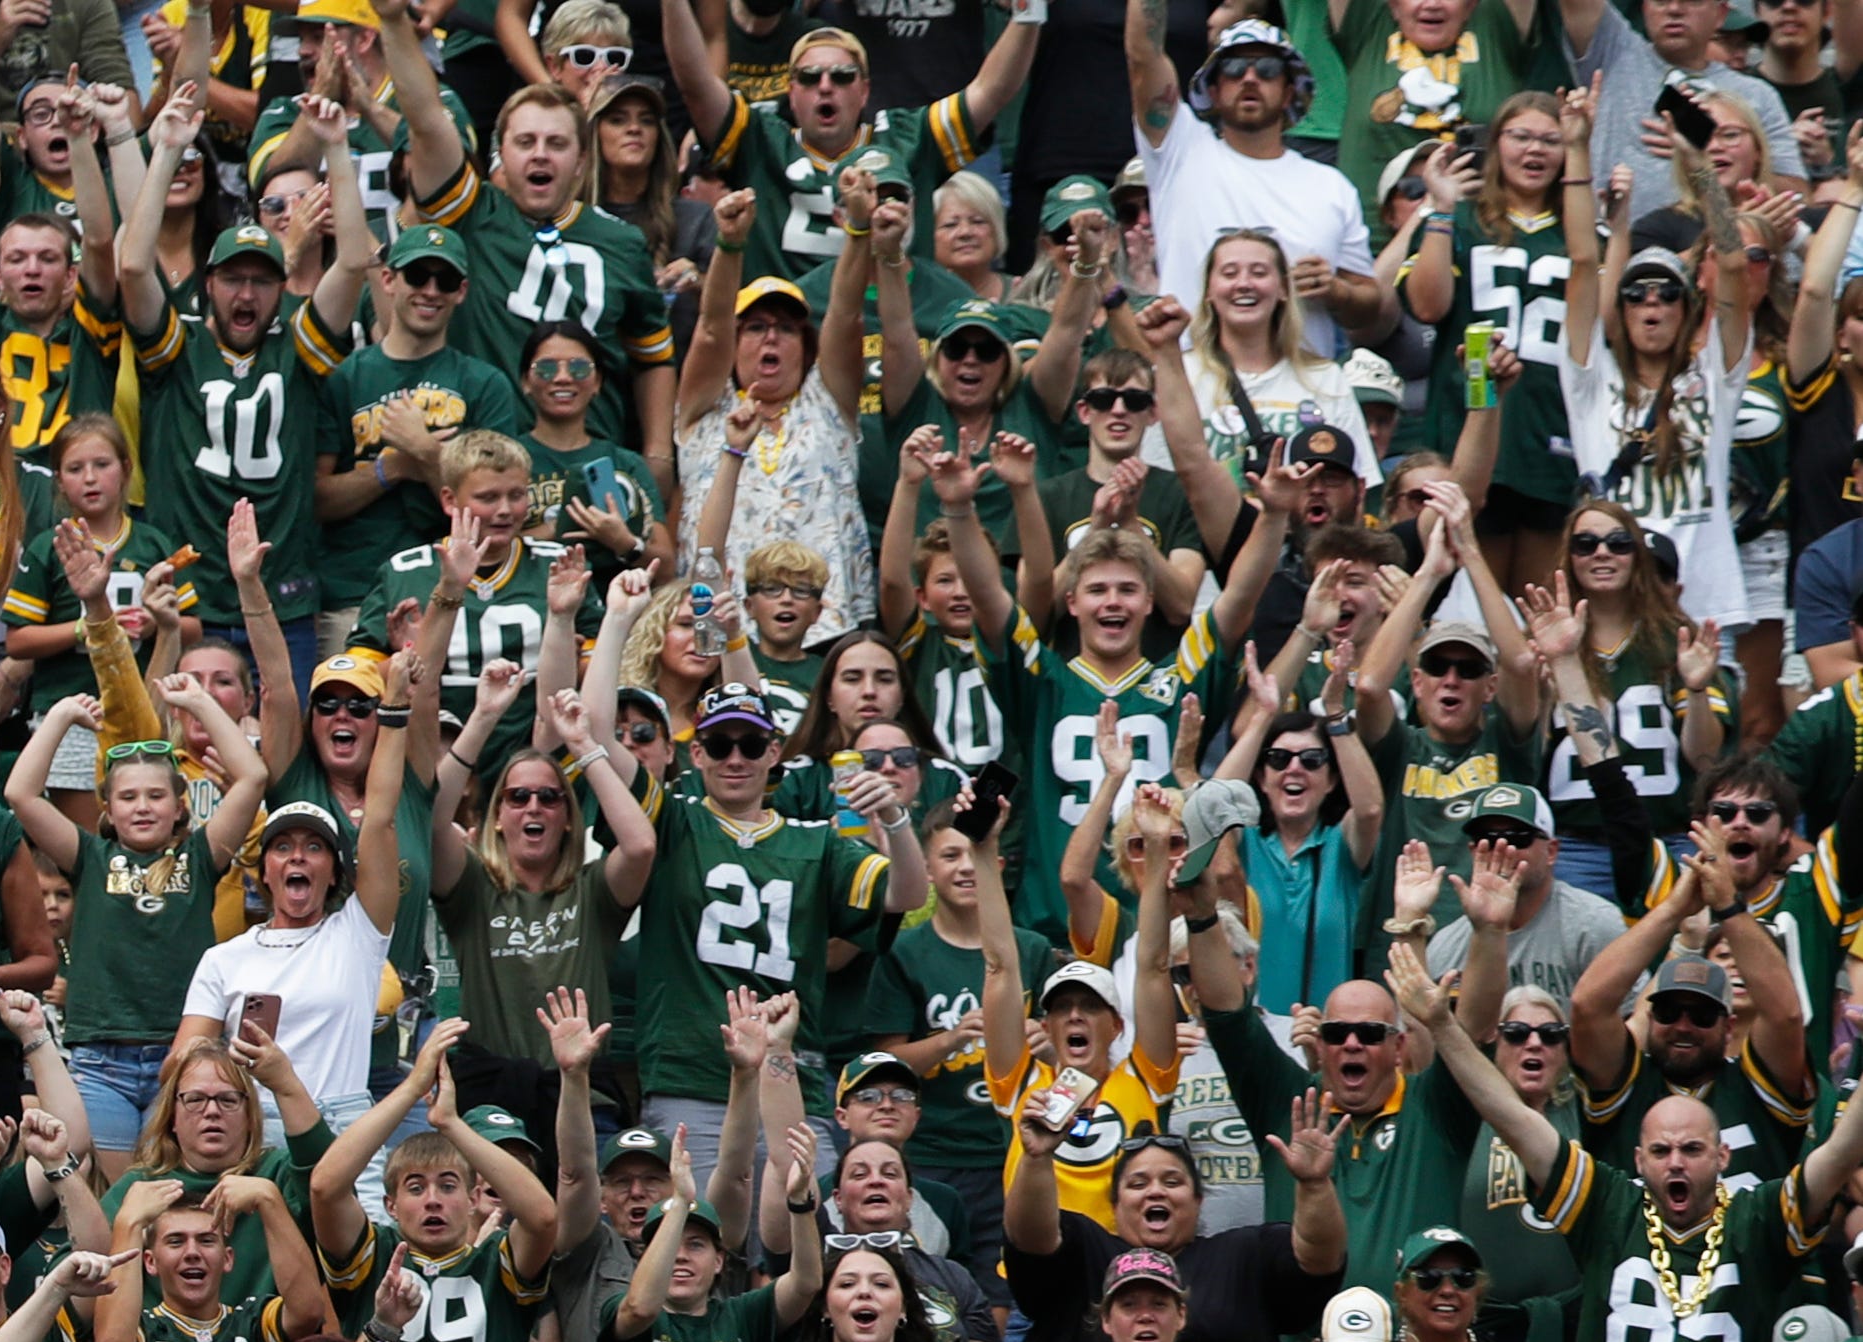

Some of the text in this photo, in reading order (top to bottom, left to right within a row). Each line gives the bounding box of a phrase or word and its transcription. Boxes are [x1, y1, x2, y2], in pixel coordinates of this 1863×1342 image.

[195, 373, 285, 479] 10
[933, 666, 1003, 766] 10
[697, 862, 795, 982] 21
[1169, 1075, 1231, 1110] REE
[617, 1129, 658, 1149] G
[1339, 1309, 1374, 1332] G
